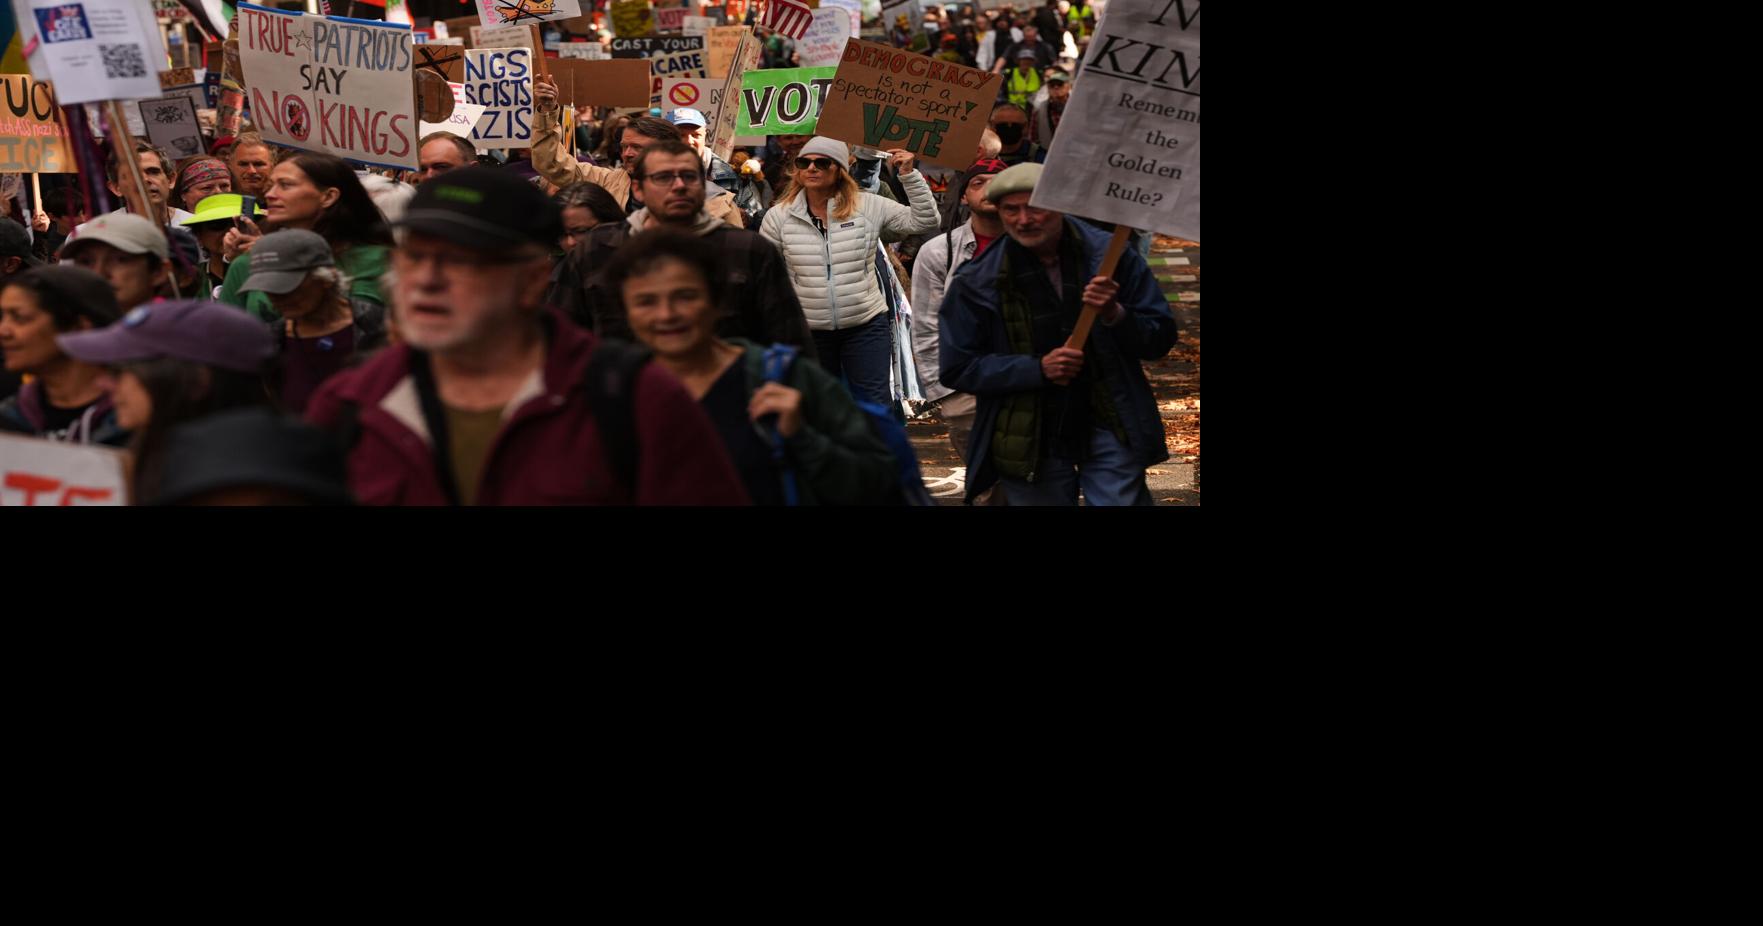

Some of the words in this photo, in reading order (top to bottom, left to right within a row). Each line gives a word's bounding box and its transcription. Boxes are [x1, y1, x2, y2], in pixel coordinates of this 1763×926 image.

[1148, 0, 1200, 31] N
[242, 8, 295, 57] TRUE
[313, 21, 411, 71] PATRIOTS
[612, 38, 653, 50] CAST
[661, 37, 700, 49] YOUR
[465, 50, 528, 81] NGS
[842, 41, 994, 90] DEMOCRACY
[1086, 34, 1200, 89] KIN
[300, 64, 347, 95] SAY
[465, 77, 531, 107] SCISTS
[878, 73, 893, 88] is
[900, 80, 932, 95] not
[940, 88, 951, 100] a
[742, 78, 834, 128] VOT
[835, 78, 914, 106] spectator
[919, 98, 978, 121] sport!
[1118, 92, 1200, 124] Remem
[319, 99, 410, 158] KINGS
[448, 114, 470, 125] USA
[471, 107, 532, 140] ZIS
[863, 102, 950, 158] VOTE
[0, 136, 59, 173] ICE
[1145, 130, 1179, 150] the
[1107, 152, 1183, 180] Golden
[1105, 181, 1163, 207] Rule?
